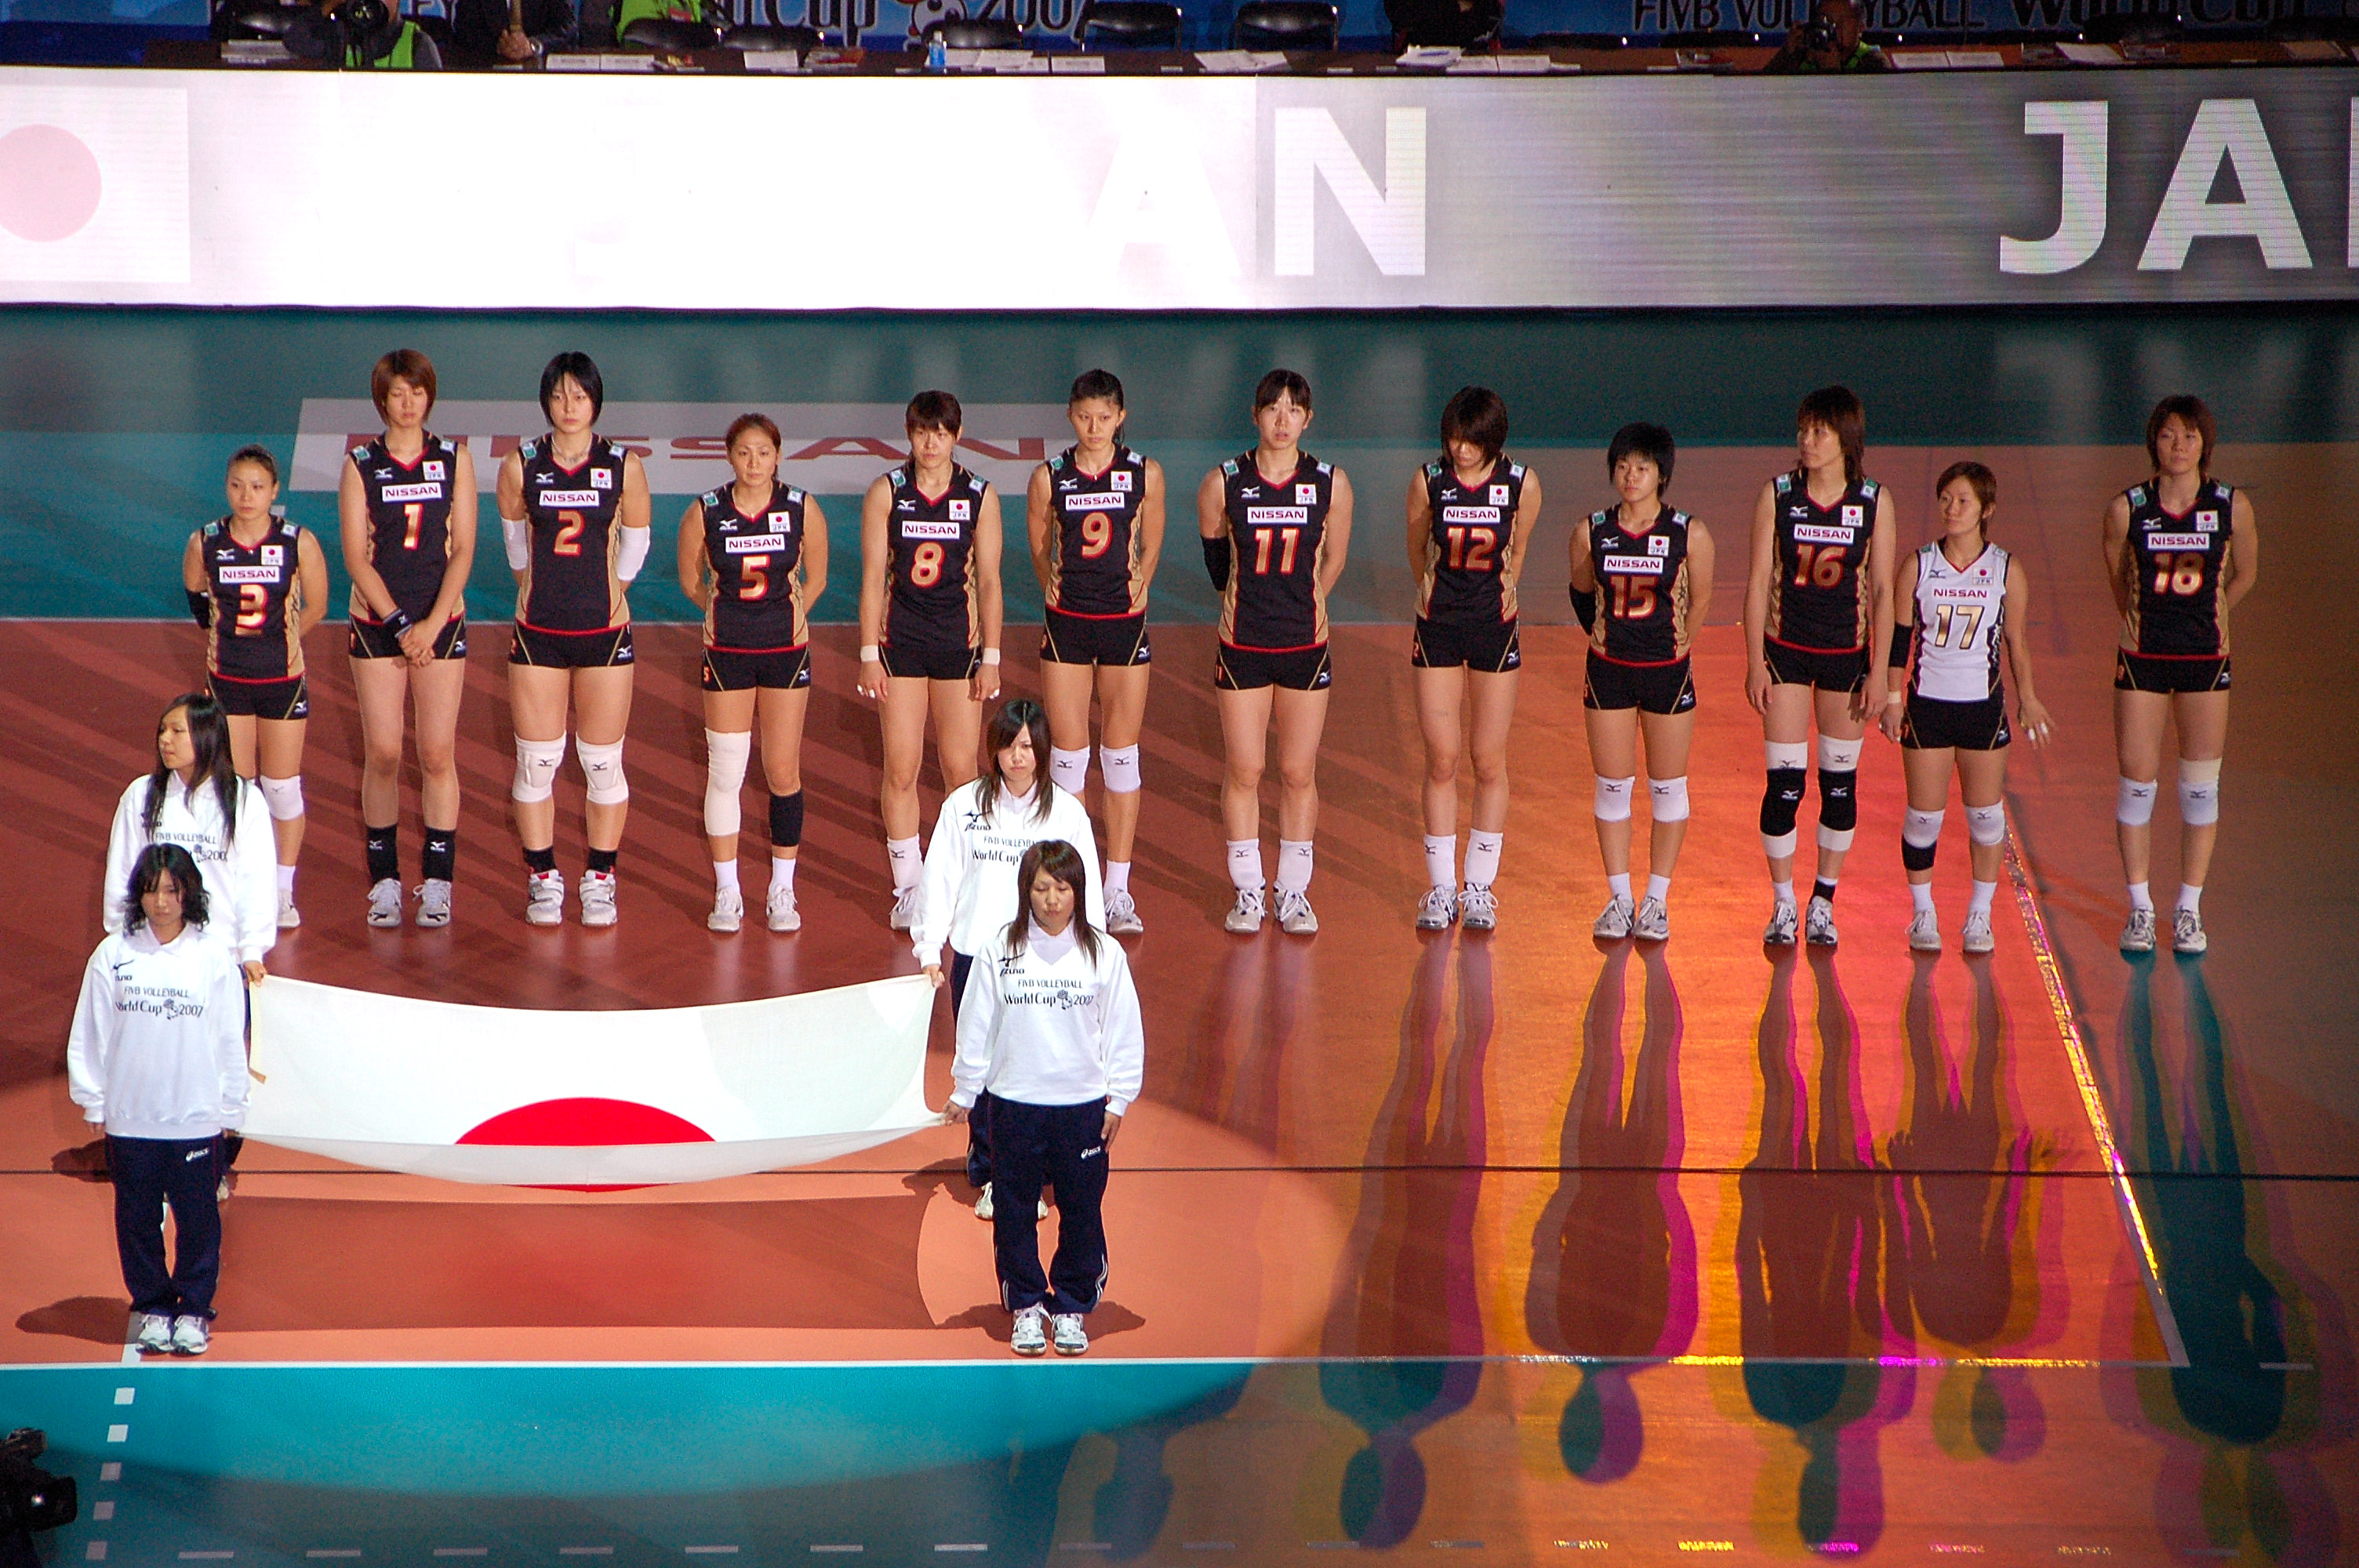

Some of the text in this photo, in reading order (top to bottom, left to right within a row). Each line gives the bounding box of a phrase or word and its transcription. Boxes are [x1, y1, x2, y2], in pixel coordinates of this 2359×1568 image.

[1735, 0, 1985, 29] VOYBALL
[2000, 98, 2359, 276] JA
[343, 434, 1045, 461] ISAN
[385, 487, 438, 497] NISSAN
[543, 494, 596, 503] NISSAN
[1068, 496, 1121, 506] NISSAN
[1446, 510, 1498, 518] NISSAN
[403, 503, 423, 550] 1
[554, 510, 584, 557] 2
[904, 524, 957, 535] NISSAN
[1797, 528, 1851, 539] NISSAN
[1081, 511, 1113, 559] 9
[2151, 536, 2207, 546] NISSAN
[729, 538, 781, 549] NISSAN
[1255, 528, 1300, 575] 11
[1446, 525, 1497, 571] 12
[910, 541, 946, 589] 8
[1607, 559, 1660, 569] NISSAN
[1794, 543, 1848, 589] 16
[222, 570, 276, 579] NISSAN
[739, 554, 771, 601] 5
[1610, 575, 1659, 619] 15
[1933, 588, 1988, 598] NISSAN
[235, 583, 268, 637] 3
[1935, 604, 1984, 650] 17
[983, 836, 1038, 848] FIVB VOLLEYB
[206, 850, 228, 862] 200
[972, 849, 1019, 866] World Cup
[1018, 979, 1084, 989] FIVB VOLLEYBALL
[124, 986, 190, 999] FIVB VOLLEYBALL
[1004, 992, 1033, 1005] World
[1034, 992, 1056, 1008] Cup
[140, 999, 162, 1018] Cup
[179, 1004, 204, 1018] 2007
